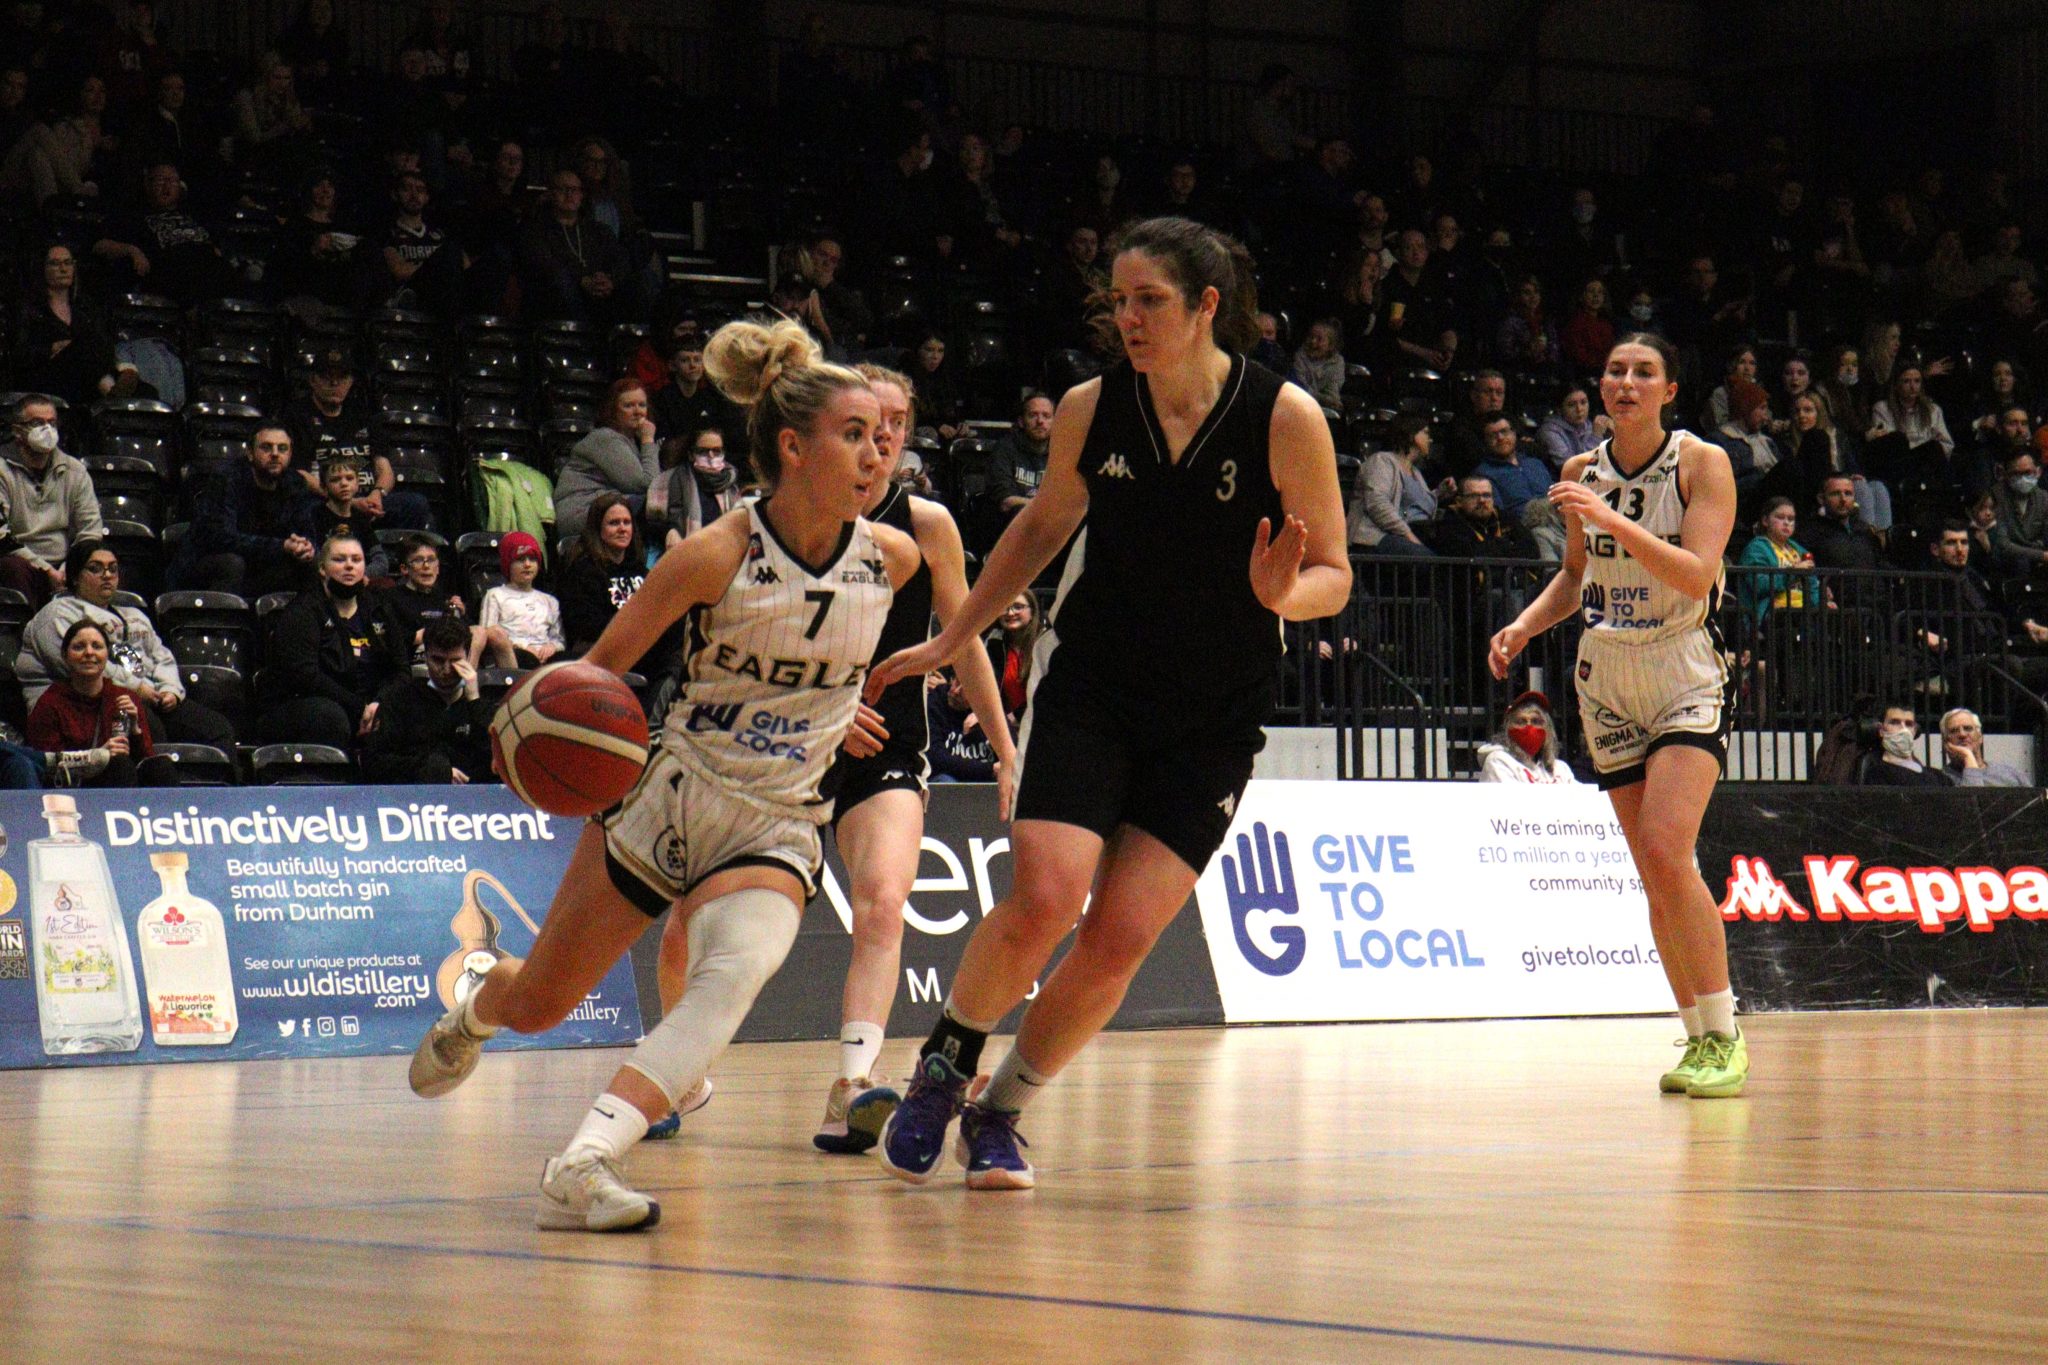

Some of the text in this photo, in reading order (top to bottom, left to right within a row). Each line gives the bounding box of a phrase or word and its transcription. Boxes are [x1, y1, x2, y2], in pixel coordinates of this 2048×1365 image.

[1216, 459, 1238, 501] 3
[1606, 487, 1645, 522] 13
[1610, 587, 1649, 601] GIVE
[804, 590, 835, 640] 7
[1611, 603, 1634, 617] TO
[1595, 731, 1634, 750] ENIGMA
[105, 803, 555, 850] Distinctively Different
[1490, 818, 1541, 836] We're
[1546, 819, 1606, 840] aiming
[1312, 834, 1415, 874] GIVE
[1478, 846, 1628, 867] £10 million a year
[226, 855, 467, 878] Beautifully handcrafted
[230, 879, 390, 900] small batch gin
[1529, 874, 1624, 895] community
[1803, 855, 2048, 933] Kappa
[1319, 881, 1385, 921] TO
[235, 903, 374, 922] from Durham
[0, 926, 21, 934] RLD
[1, 934, 24, 950] IN
[1333, 928, 1485, 969] LOCAL
[0, 961, 26, 969] SIGN
[244, 954, 422, 972] See our unique products at
[1521, 944, 1660, 972] givetolocal.c
[0, 969, 27, 979] ONZE
[242, 971, 430, 998] www.wldistillery
[374, 994, 416, 1008] .com
[566, 1001, 620, 1025] stillery
